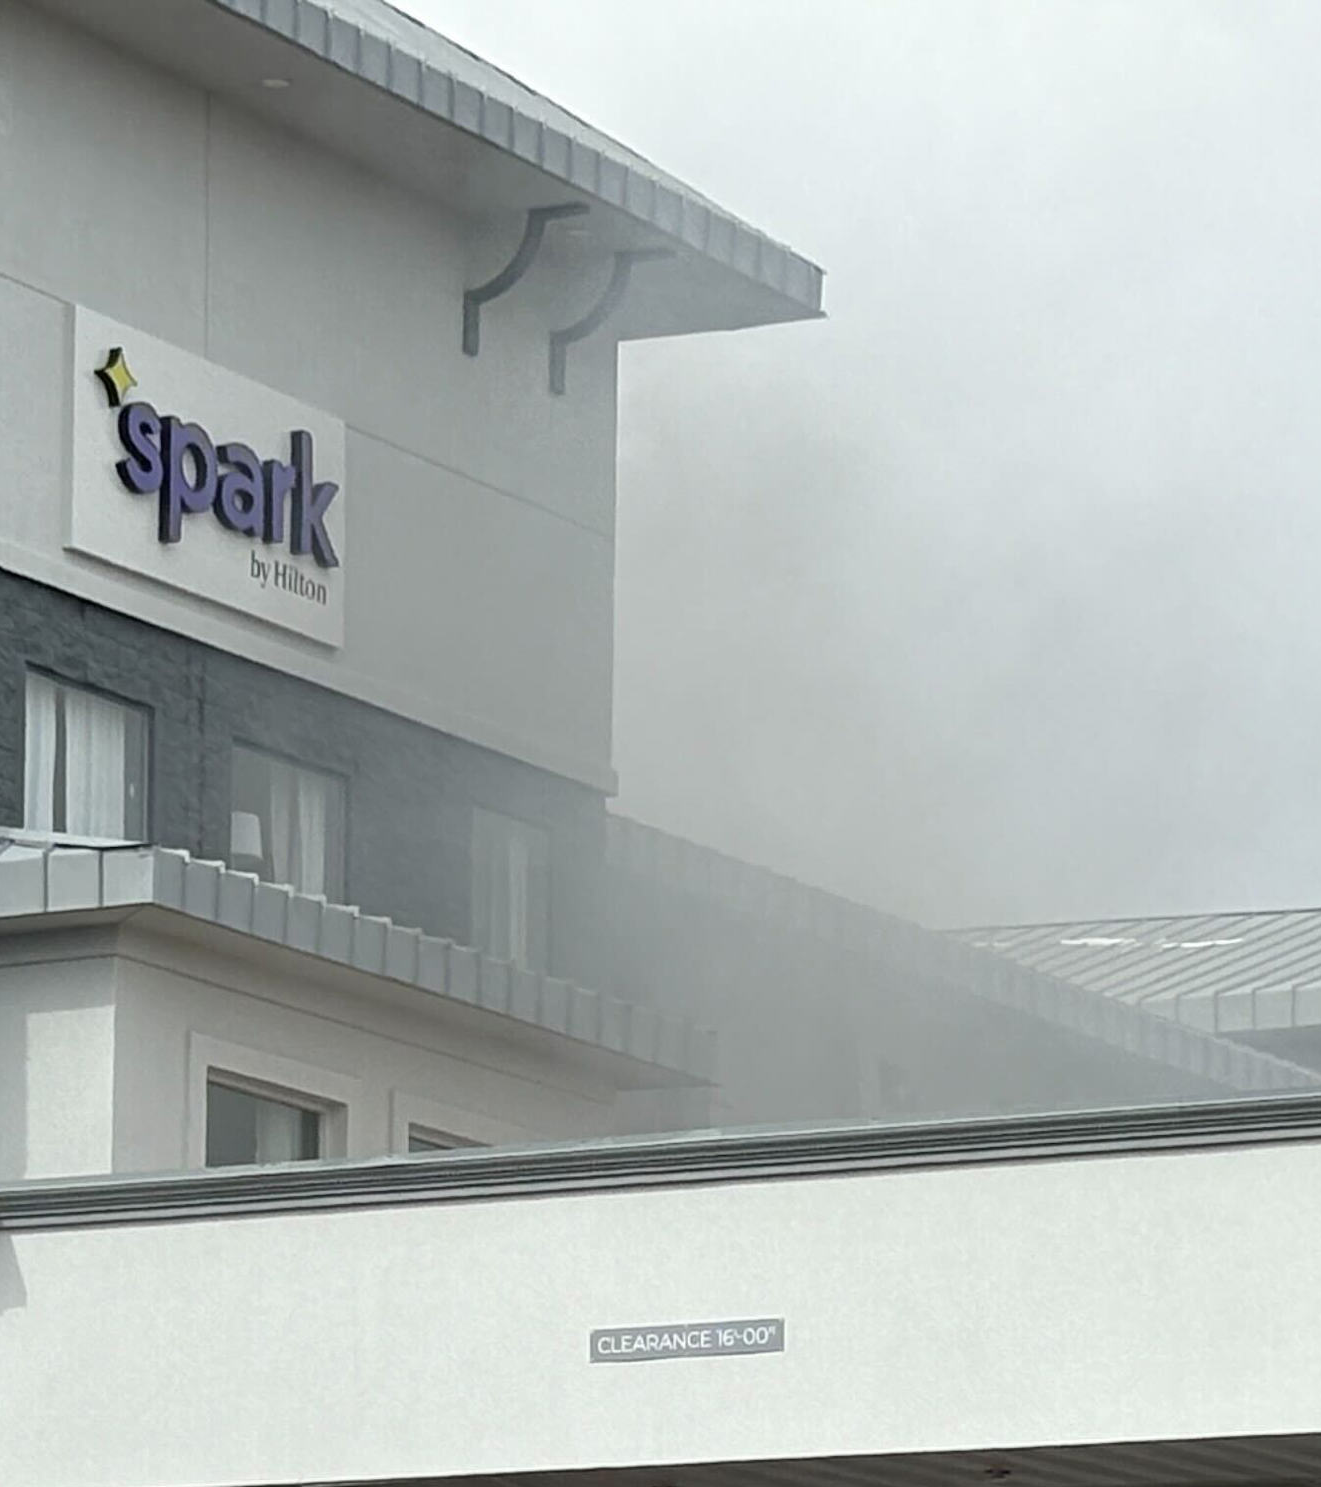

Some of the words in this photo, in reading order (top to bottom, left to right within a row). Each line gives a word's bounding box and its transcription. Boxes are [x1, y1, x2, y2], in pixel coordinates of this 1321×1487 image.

[116, 402, 339, 567] spark
[251, 549, 272, 589] by
[275, 560, 327, 605] Hilton
[597, 1330, 712, 1354] CLEARANCE
